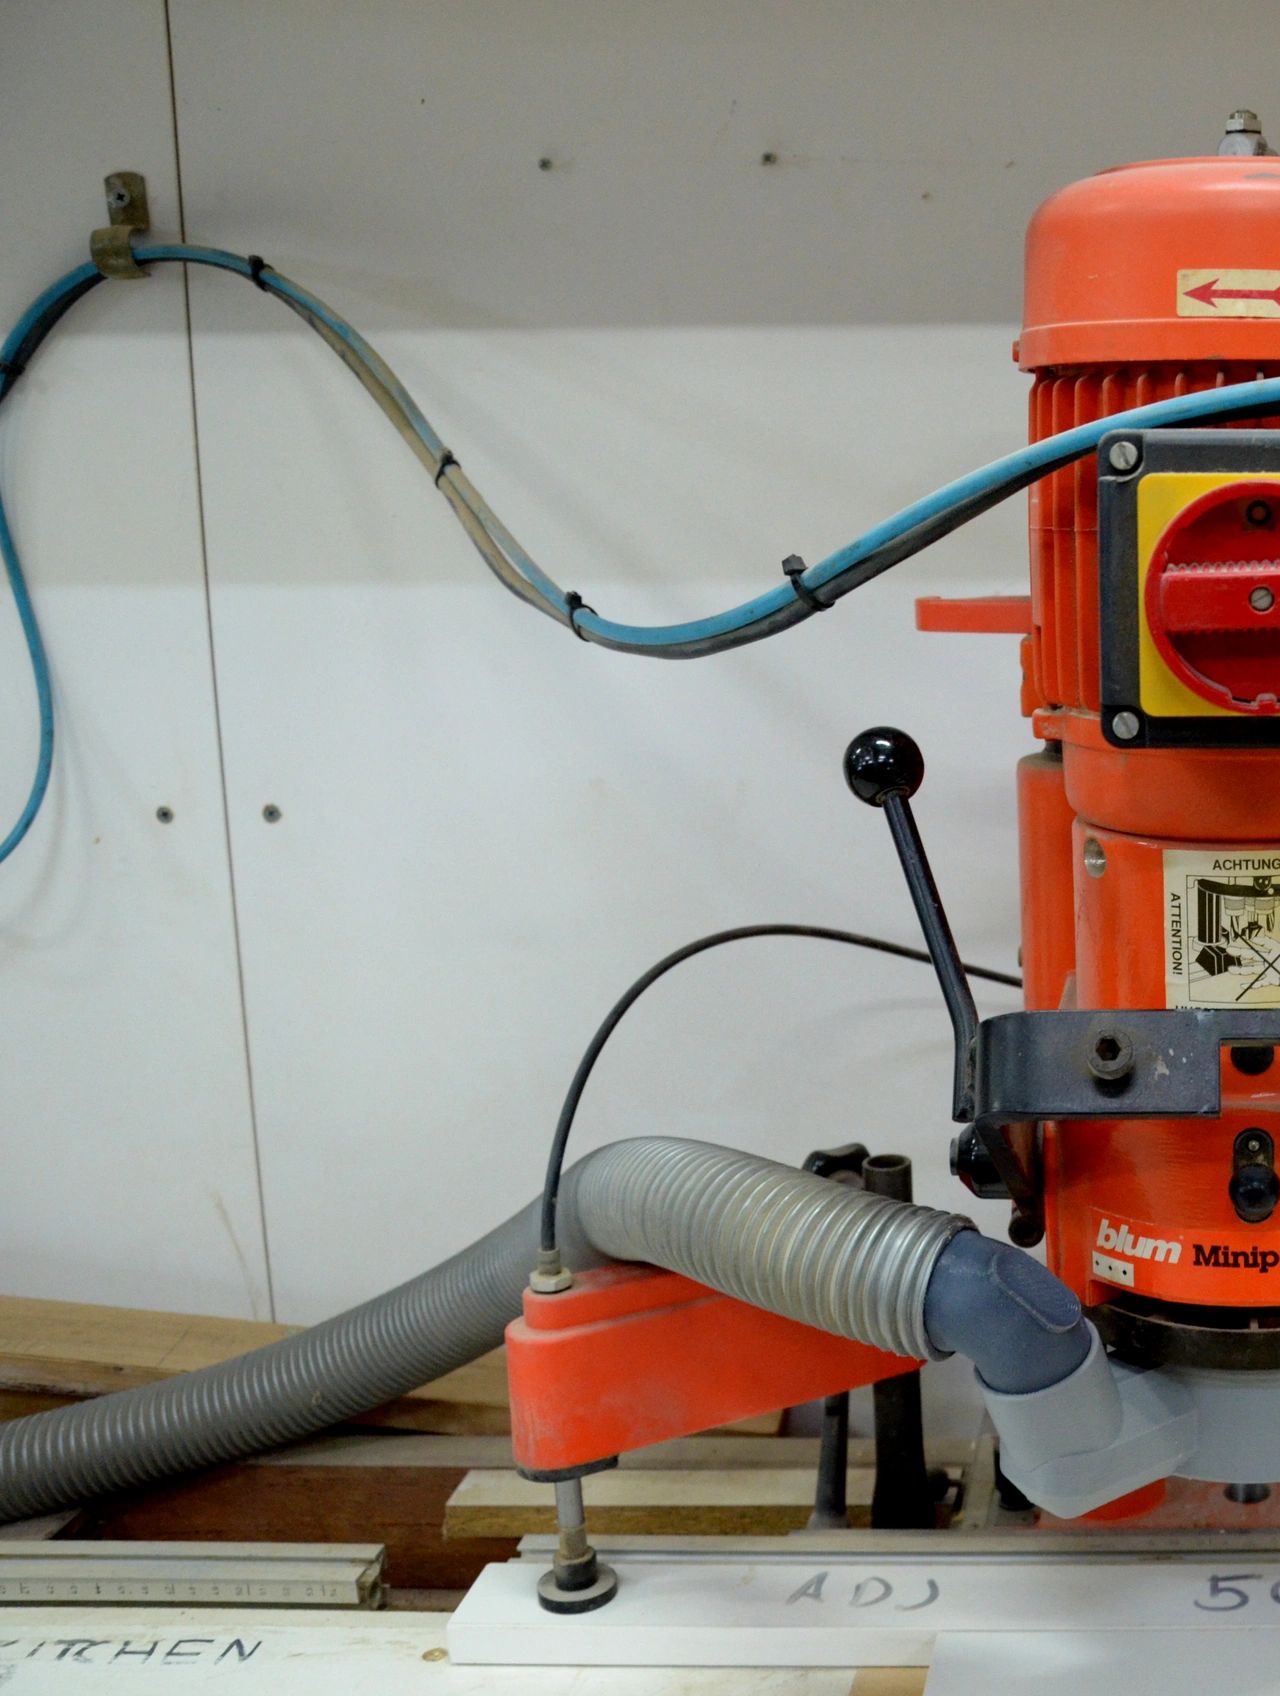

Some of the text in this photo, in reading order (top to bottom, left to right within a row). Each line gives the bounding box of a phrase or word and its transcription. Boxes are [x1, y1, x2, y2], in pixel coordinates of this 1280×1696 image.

[1170, 893, 1183, 975] ATTENTION!
[1096, 1218, 1182, 1264] blum
[785, 1571, 940, 1611] ADJ
[0, 1637, 262, 1665] ITCHEN
